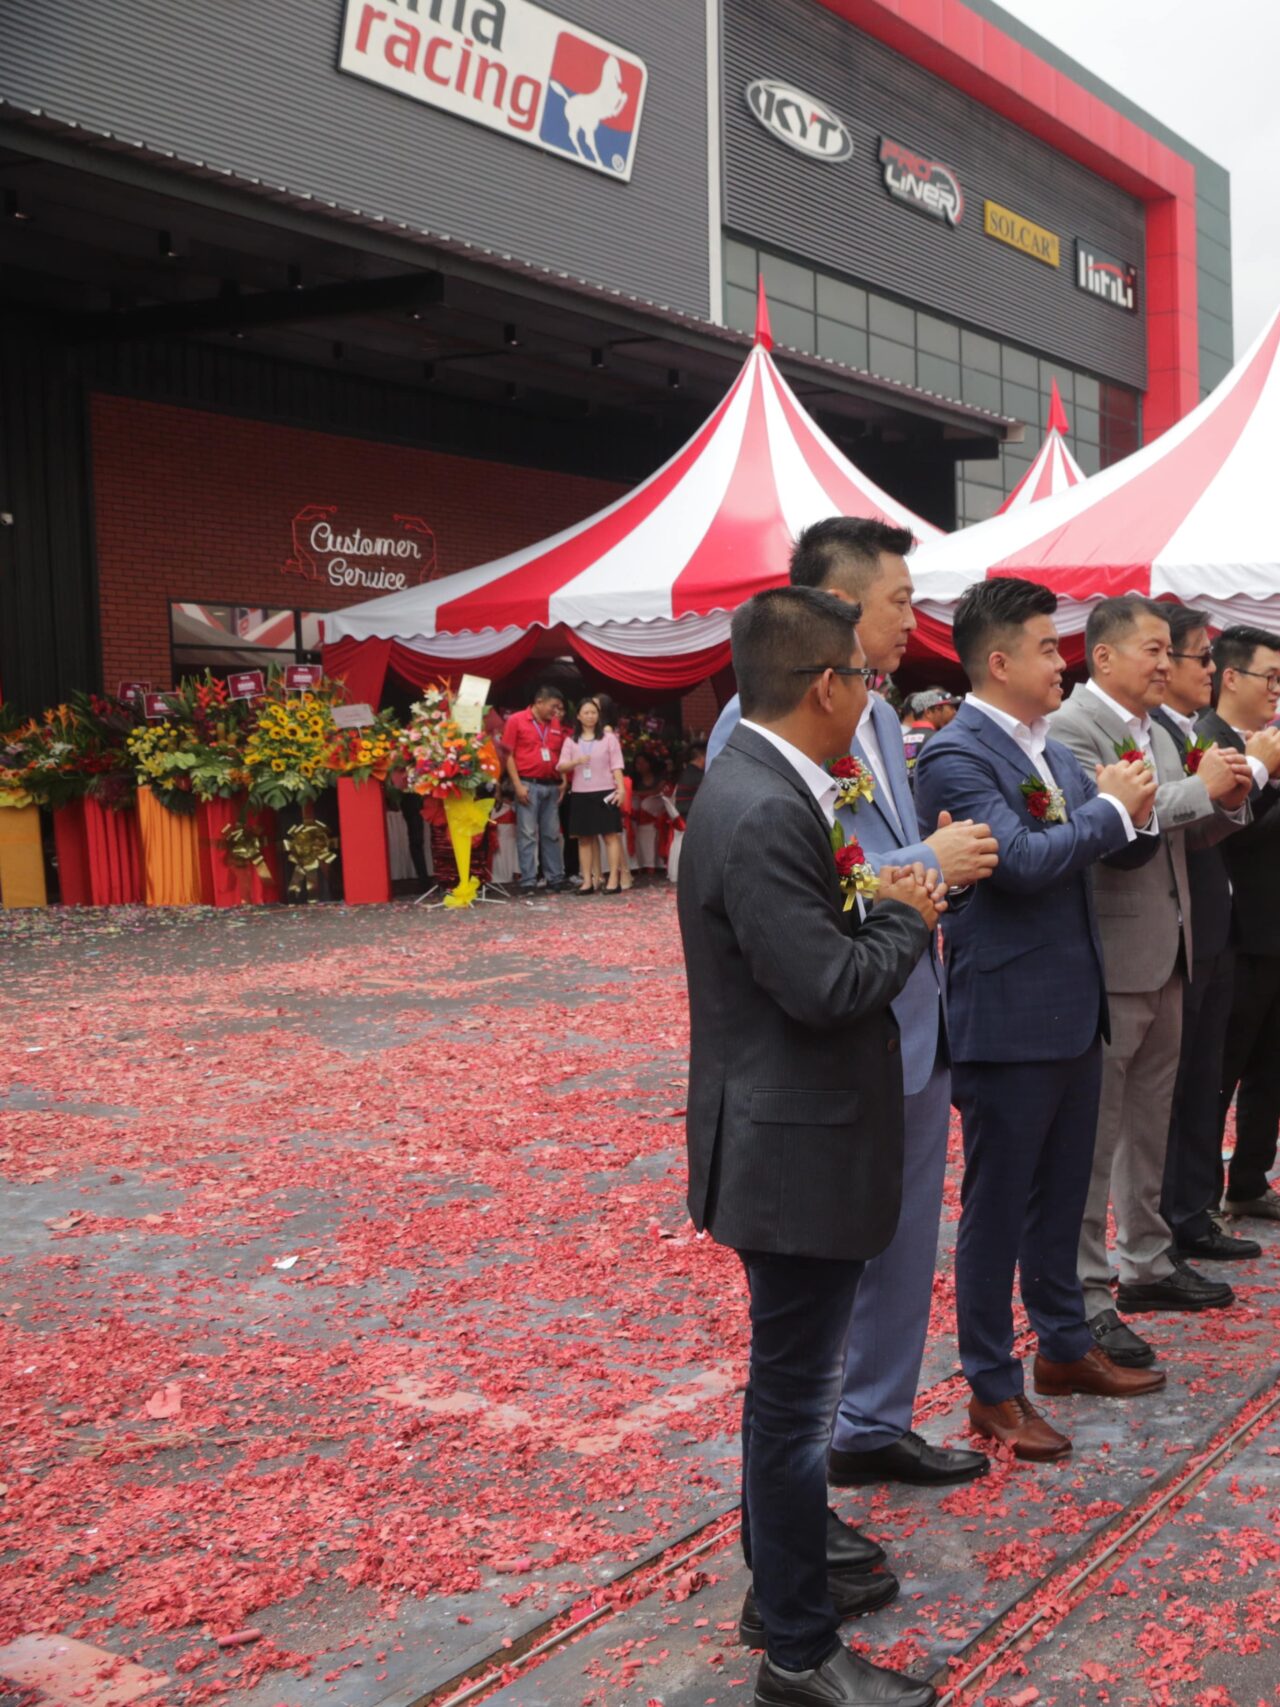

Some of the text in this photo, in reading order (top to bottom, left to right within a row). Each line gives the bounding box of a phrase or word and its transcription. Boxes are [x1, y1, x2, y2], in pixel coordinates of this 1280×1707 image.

[355, 3, 542, 132] racing
[763, 87, 839, 150] KYT
[990, 210, 1051, 259] SOLCAR
[310, 522, 422, 559] Customer
[328, 557, 408, 591] Service
